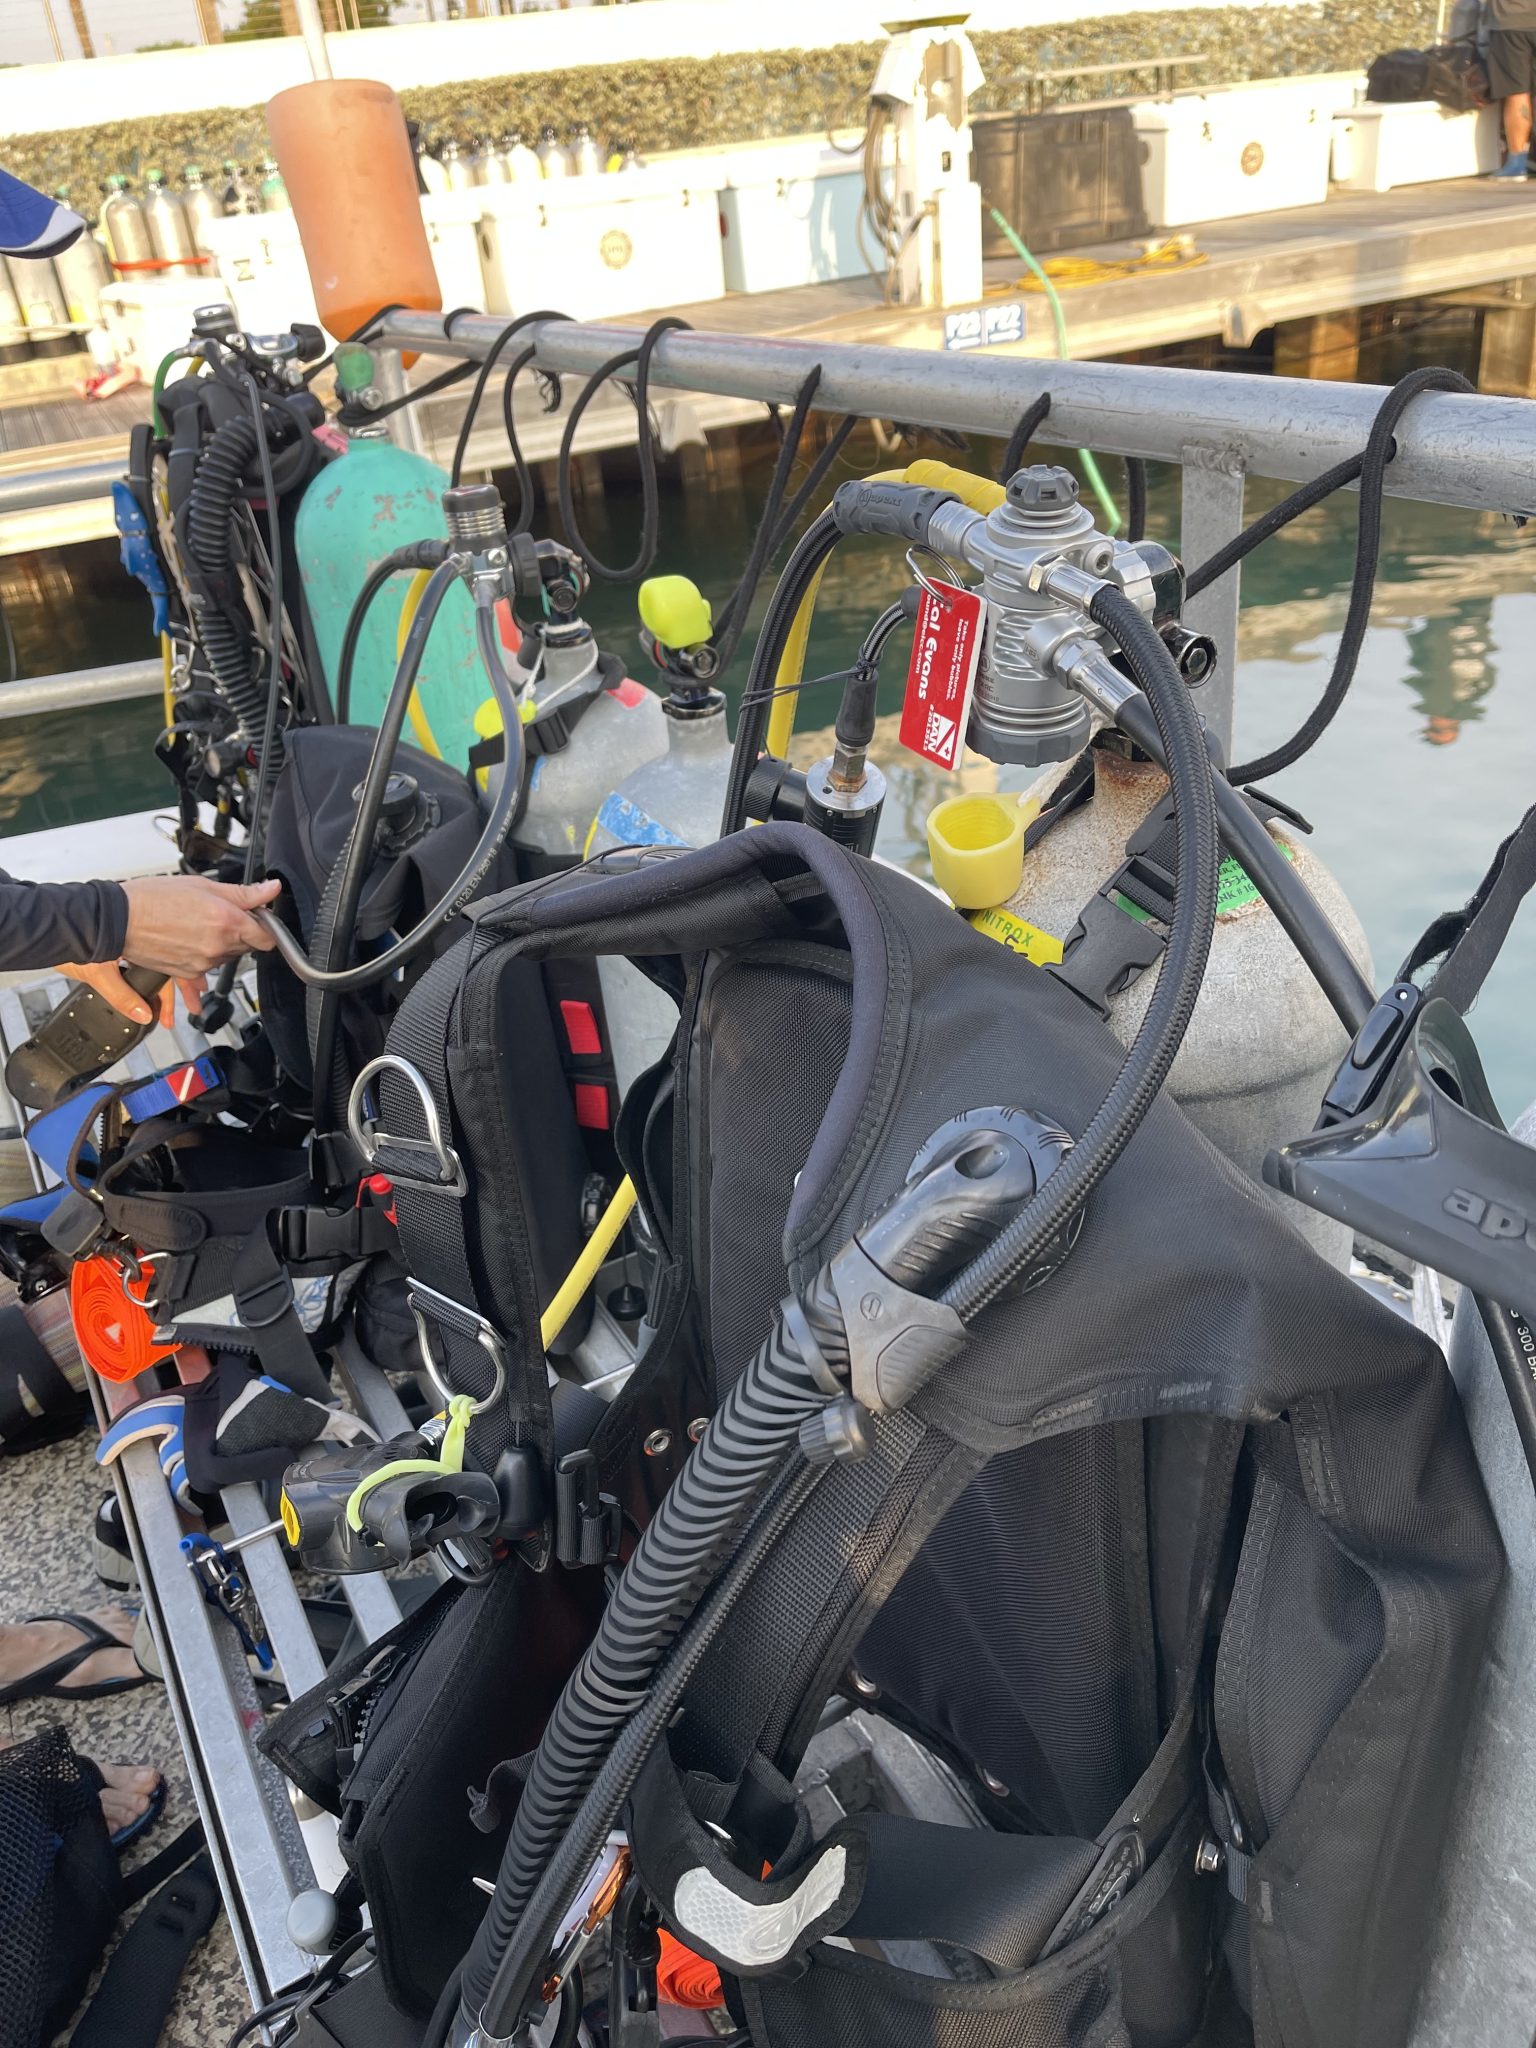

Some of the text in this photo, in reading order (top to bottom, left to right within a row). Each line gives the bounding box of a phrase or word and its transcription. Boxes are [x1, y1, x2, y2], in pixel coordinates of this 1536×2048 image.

[955, 618, 964, 642] leave
[961, 620, 969, 641] Take
[918, 637, 937, 700] Evans
[926, 712, 941, 752] DAN
[455, 888, 473, 907] 0120
[470, 874, 481, 889] EN
[982, 909, 1034, 947] NITROX
[1517, 1326, 1535, 1352] 300
